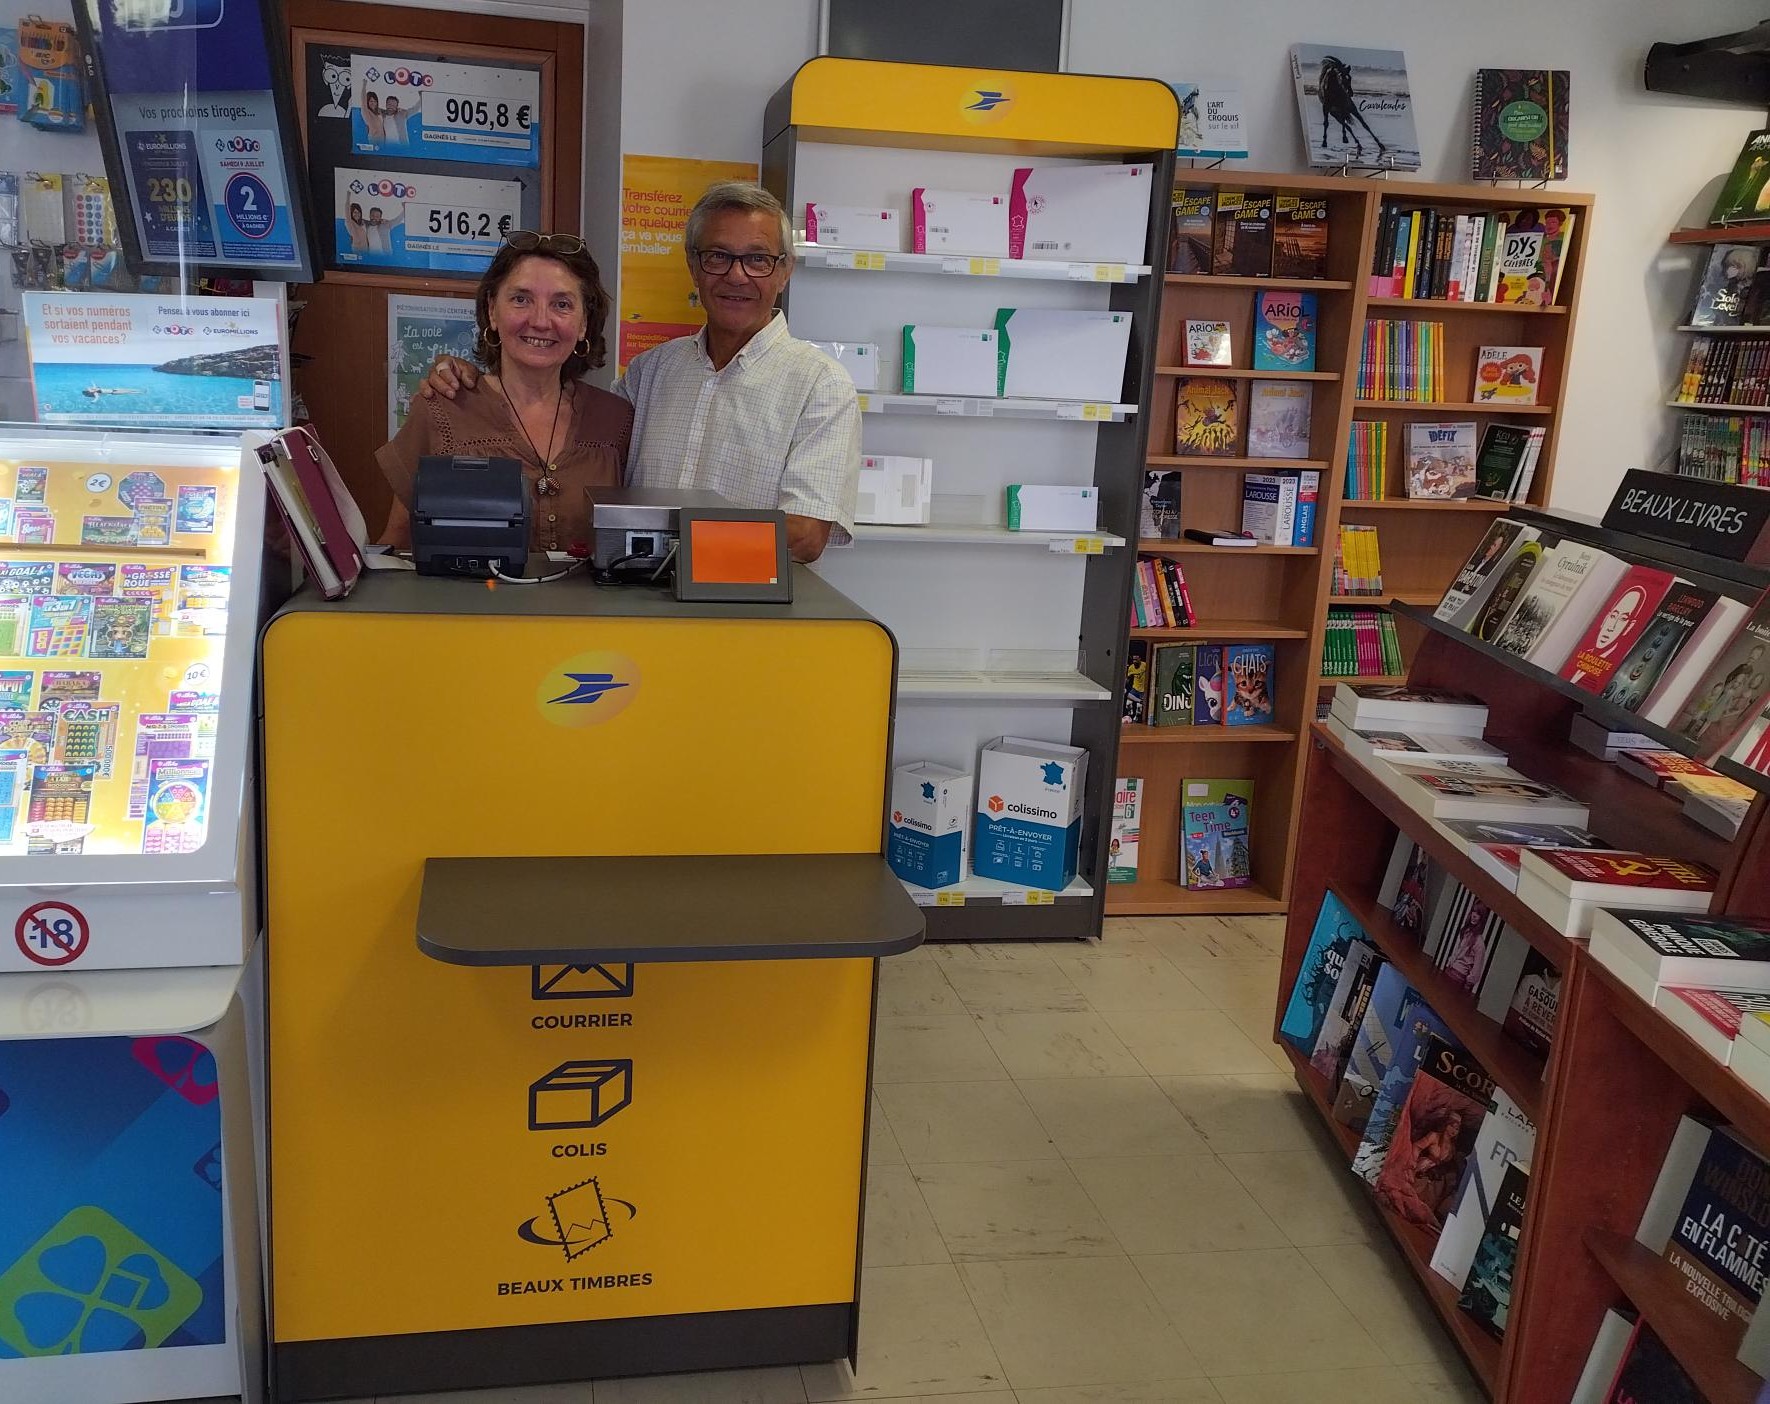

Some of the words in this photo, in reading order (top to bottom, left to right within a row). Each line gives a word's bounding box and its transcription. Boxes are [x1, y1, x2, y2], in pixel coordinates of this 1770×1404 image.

[383, 66, 434, 87] LOTO
[1207, 101, 1225, 109] L'ART
[1359, 99, 1406, 112] Cavalcades
[139, 106, 157, 119] Vos
[446, 99, 509, 131] 905,8
[515, 104, 530, 130] €
[1207, 114, 1239, 122] CROQUIS
[227, 135, 261, 152] LOTO
[423, 132, 447, 141] GAGNÉS
[449, 134, 457, 142] LE
[147, 178, 192, 203] 230
[367, 178, 416, 198] LOTO
[240, 185, 257, 211] 2
[623, 188, 683, 203] Transférez
[1183, 196, 1212, 206] ESCAPE
[623, 203, 651, 214] votre
[1243, 199, 1271, 209] ESCAPE
[1300, 200, 1327, 210] ESCAPE
[1175, 206, 1200, 217] GAME
[1234, 208, 1260, 220] GAME
[1291, 209, 1316, 220] GAME
[428, 209, 491, 241] 516,2
[497, 214, 512, 237] €
[622, 217, 636, 226] en
[622, 231, 635, 241] ça
[639, 231, 652, 240] va
[655, 231, 682, 242] vous
[406, 241, 431, 251] GAGNÉS
[433, 243, 440, 251] LE
[622, 242, 672, 255] emballer
[1507, 236, 1537, 258] DYS
[1716, 288, 1740, 304] Solo
[42, 303, 52, 316] Et
[54, 304, 64, 316] si
[66, 307, 85, 317] vos
[86, 305, 131, 317] numéros
[192, 308, 209, 316] vous
[210, 306, 239, 317] abonner
[240, 307, 250, 317] ici
[44, 319, 89, 330] sortaient
[91, 319, 133, 332] pendant
[163, 324, 195, 336] LOTO
[213, 327, 259, 335] EUROMILLIONS
[403, 325, 420, 338] La
[421, 325, 443, 337] voie
[51, 335, 70, 344] vos
[1186, 385, 1211, 394] Animal
[1245, 490, 1277, 501] LAROUSSE
[1283, 487, 1294, 530] LAROUSSE
[1620, 488, 1681, 521] BEAUX
[1676, 500, 1748, 534] LIVRES
[1300, 505, 1309, 534] ANGLAIS
[9, 565, 45, 576] GOAL!
[1557, 555, 1588, 575] Cyrulnik
[123, 579, 150, 587] ROUE
[1233, 653, 1267, 675] CHATS
[1577, 651, 1586, 660] LA
[1585, 654, 1613, 671] ROULETTE
[186, 669, 199, 681] 10
[199, 669, 208, 678] €
[1007, 803, 1057, 819] colissimo
[1188, 811, 1215, 822] Teen
[903, 816, 932, 831] colissimo
[1203, 821, 1231, 833] Time
[988, 824, 1053, 841] PRÊT-À-ENVOYER
[29, 918, 74, 949] -18
[1628, 918, 1685, 955] GÉNÉRALE
[1652, 922, 1707, 956] PANIQUE
[531, 1013, 633, 1030] COURRIER
[551, 1142, 608, 1158] COLIS
[1700, 1203, 1725, 1239] LA
[1680, 1215, 1703, 1245] EN
[1700, 1232, 1769, 1296] FLAMMES
[1669, 1251, 1682, 1269] LA
[1681, 1261, 1722, 1299] NOUVELLE
[497, 1278, 564, 1297] BEAUX
[570, 1272, 653, 1293] TIMBRES
[1685, 1278, 1731, 1321] EXPLOSIVE
